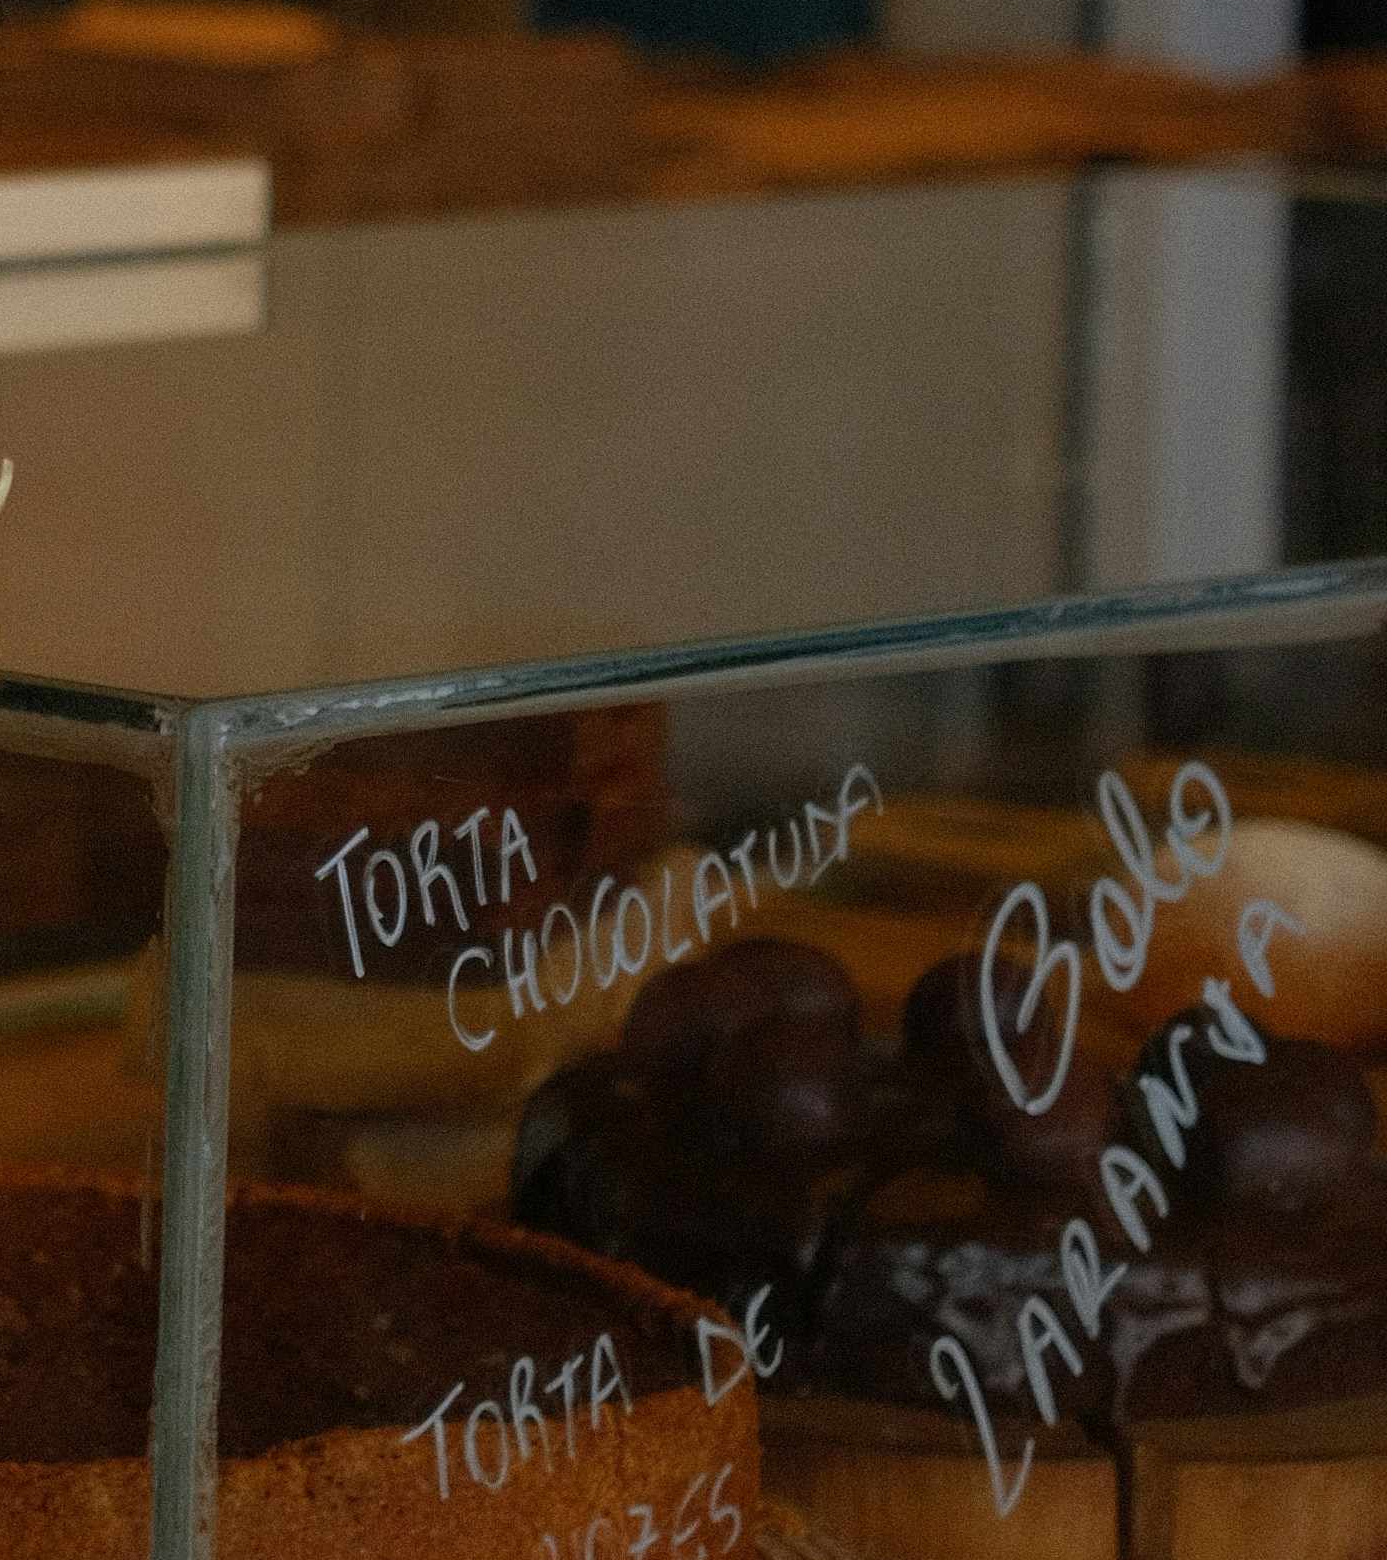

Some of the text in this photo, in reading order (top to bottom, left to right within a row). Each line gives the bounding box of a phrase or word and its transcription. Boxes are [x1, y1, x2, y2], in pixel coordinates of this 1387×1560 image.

[315, 806, 539, 980] TORTA
[446, 761, 885, 1053] CHOCOLATUDA
[979, 760, 1234, 1116] Bolo
[929, 898, 1306, 1521] LARANJA
[400, 1282, 784, 1502] TORTA DE
